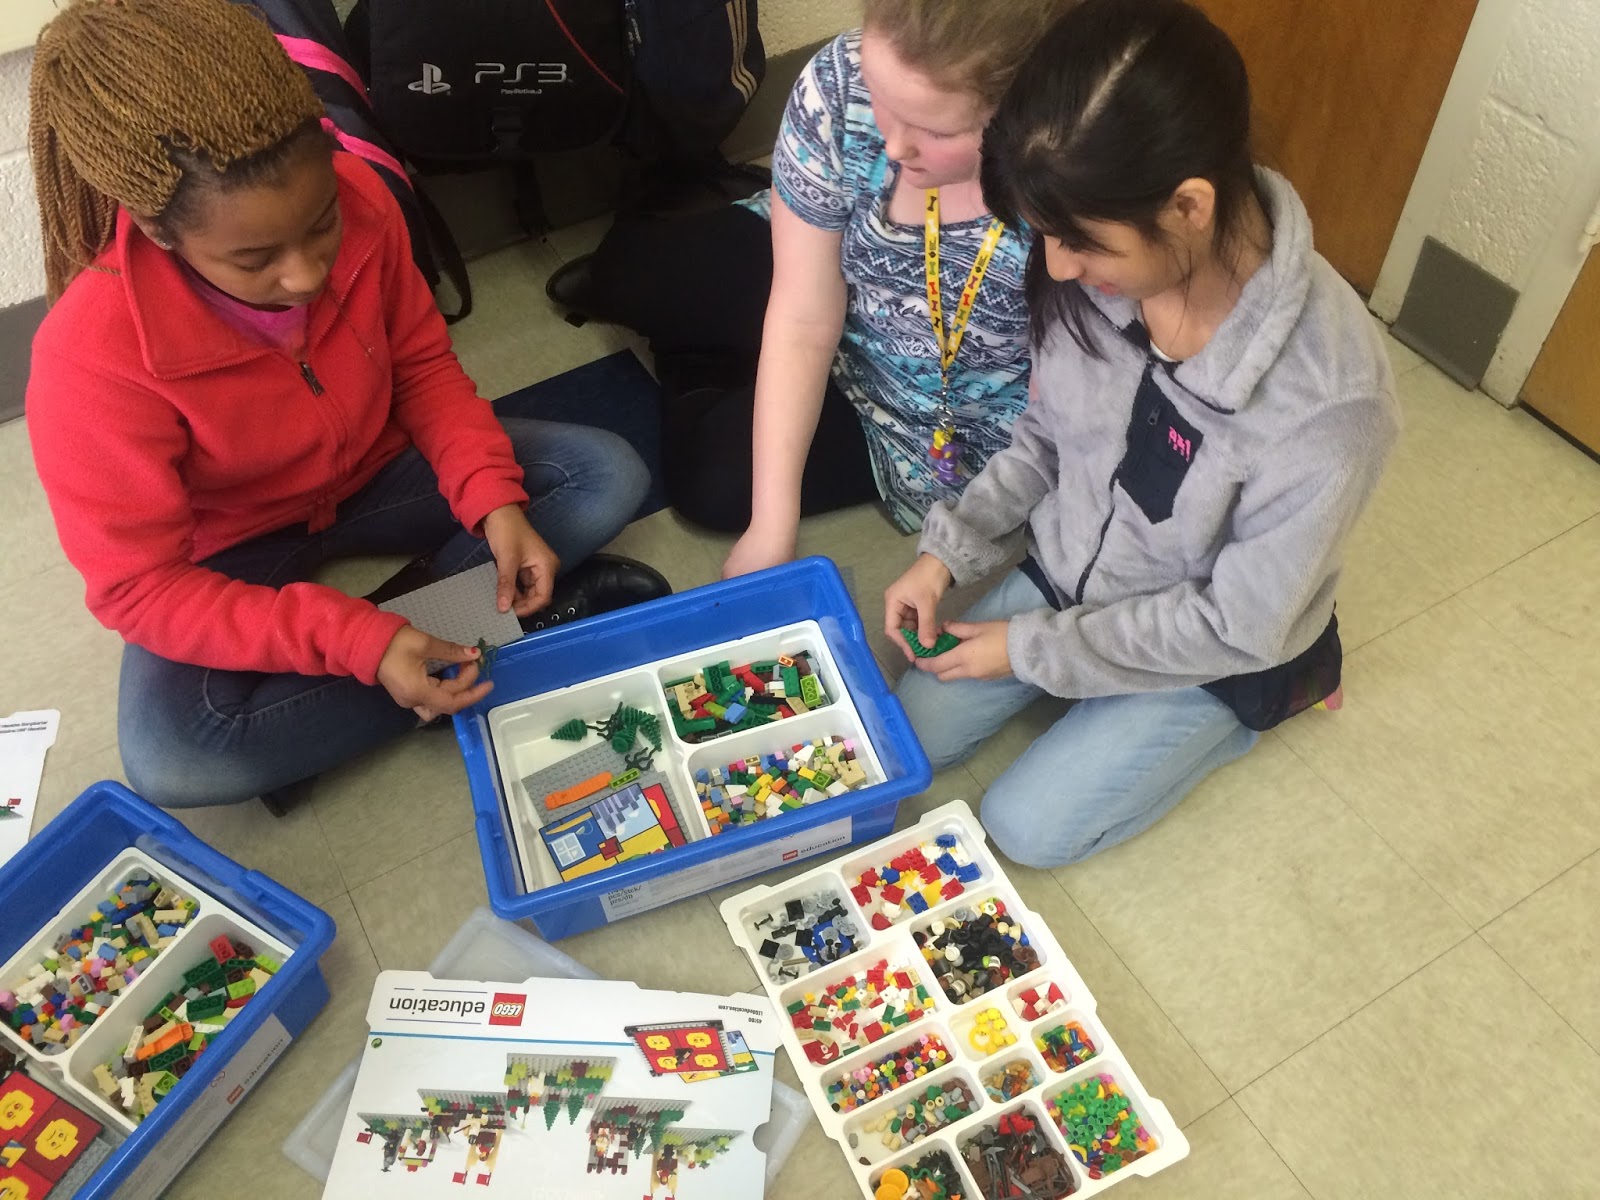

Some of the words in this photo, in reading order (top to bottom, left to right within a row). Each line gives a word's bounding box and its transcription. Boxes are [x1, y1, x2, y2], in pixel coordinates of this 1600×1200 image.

[475, 62, 568, 84] PS3
[389, 997, 486, 1017] education
[491, 1002, 525, 1017] LEGO
